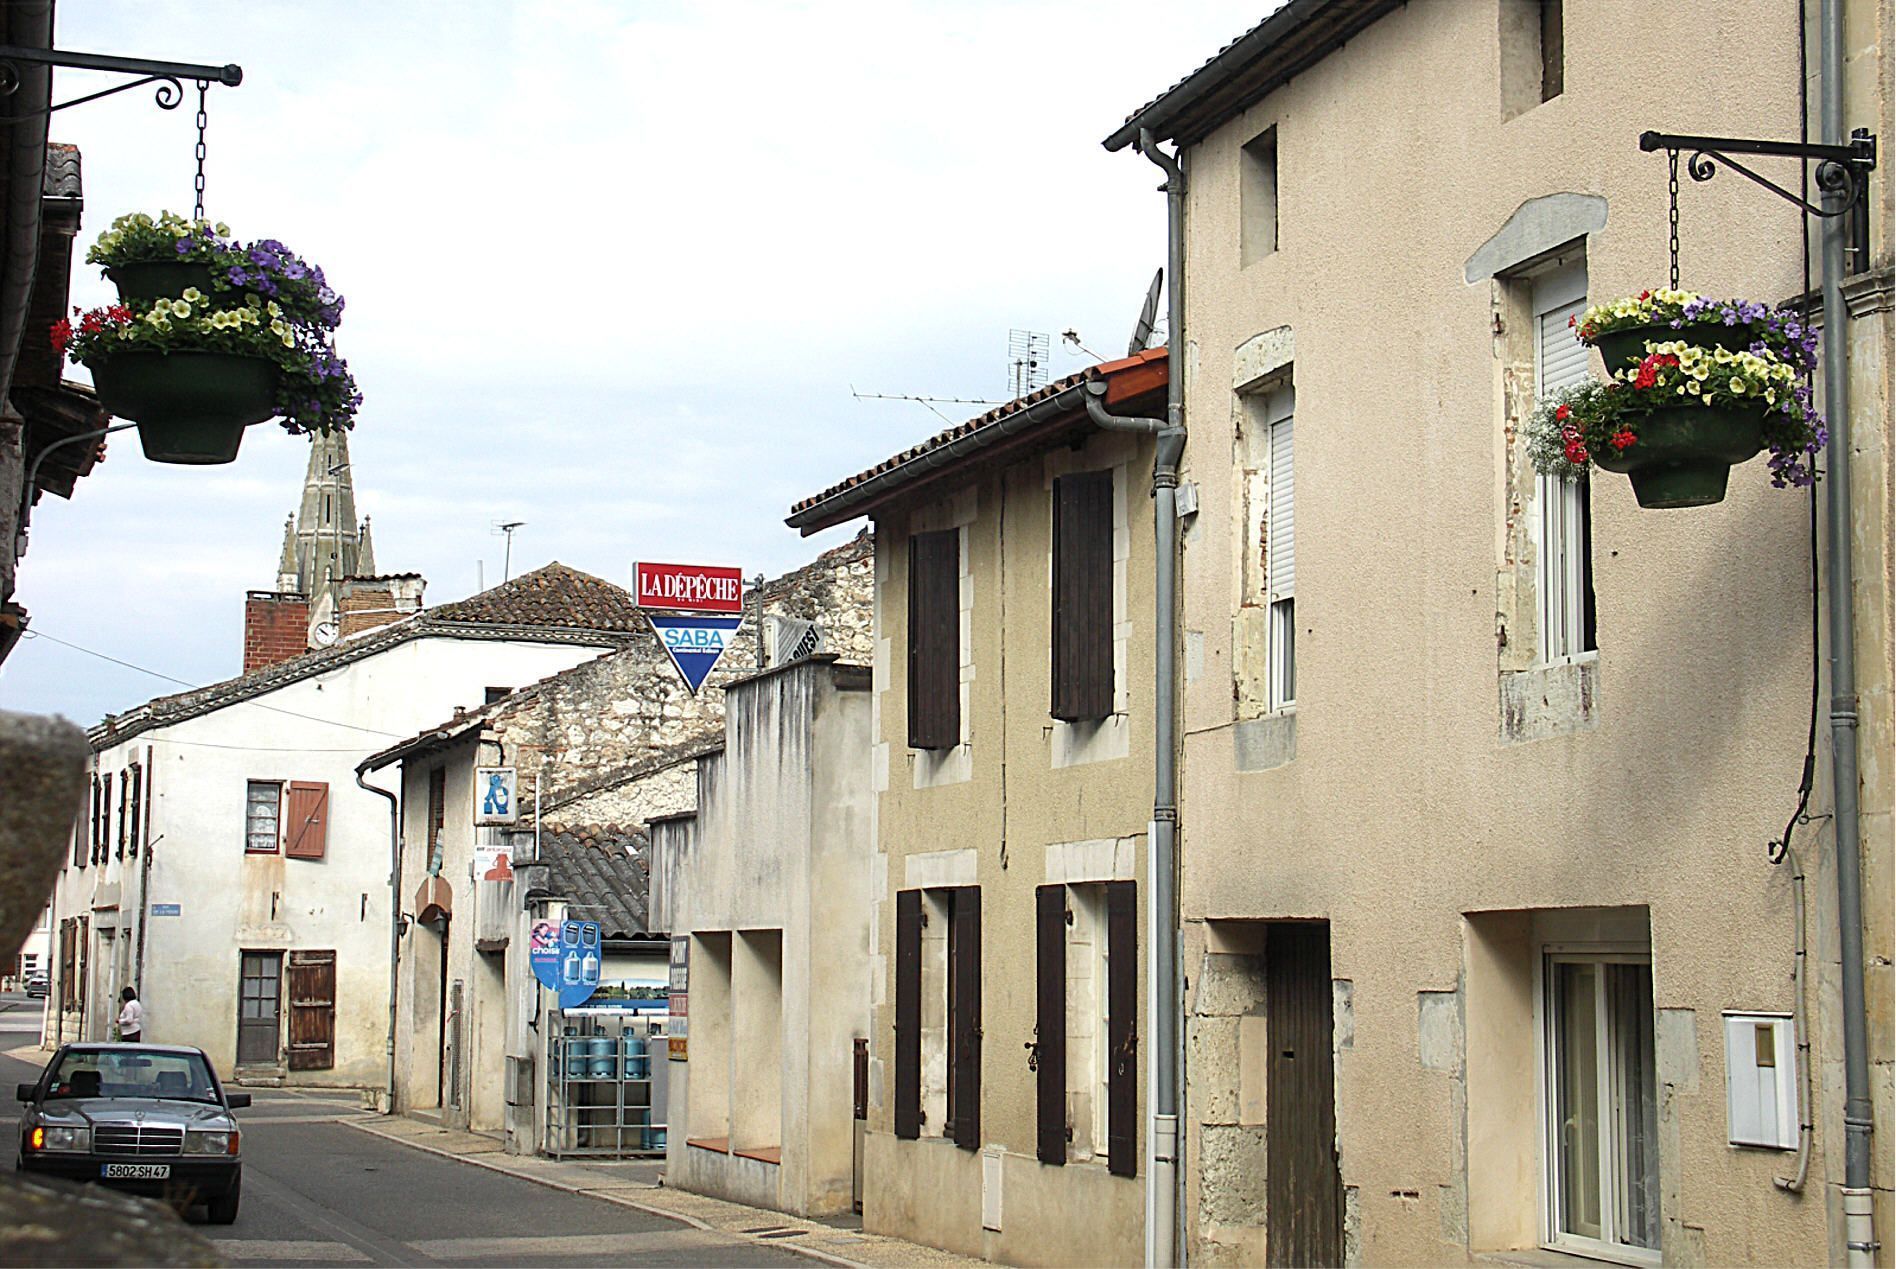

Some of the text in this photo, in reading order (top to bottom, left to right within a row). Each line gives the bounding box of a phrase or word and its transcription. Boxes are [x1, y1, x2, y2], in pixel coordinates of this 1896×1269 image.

[641, 571, 739, 601] LA DÉPÊCHE
[664, 628, 724, 647] SABA
[109, 1165, 167, 1178] 5802 SH 47
